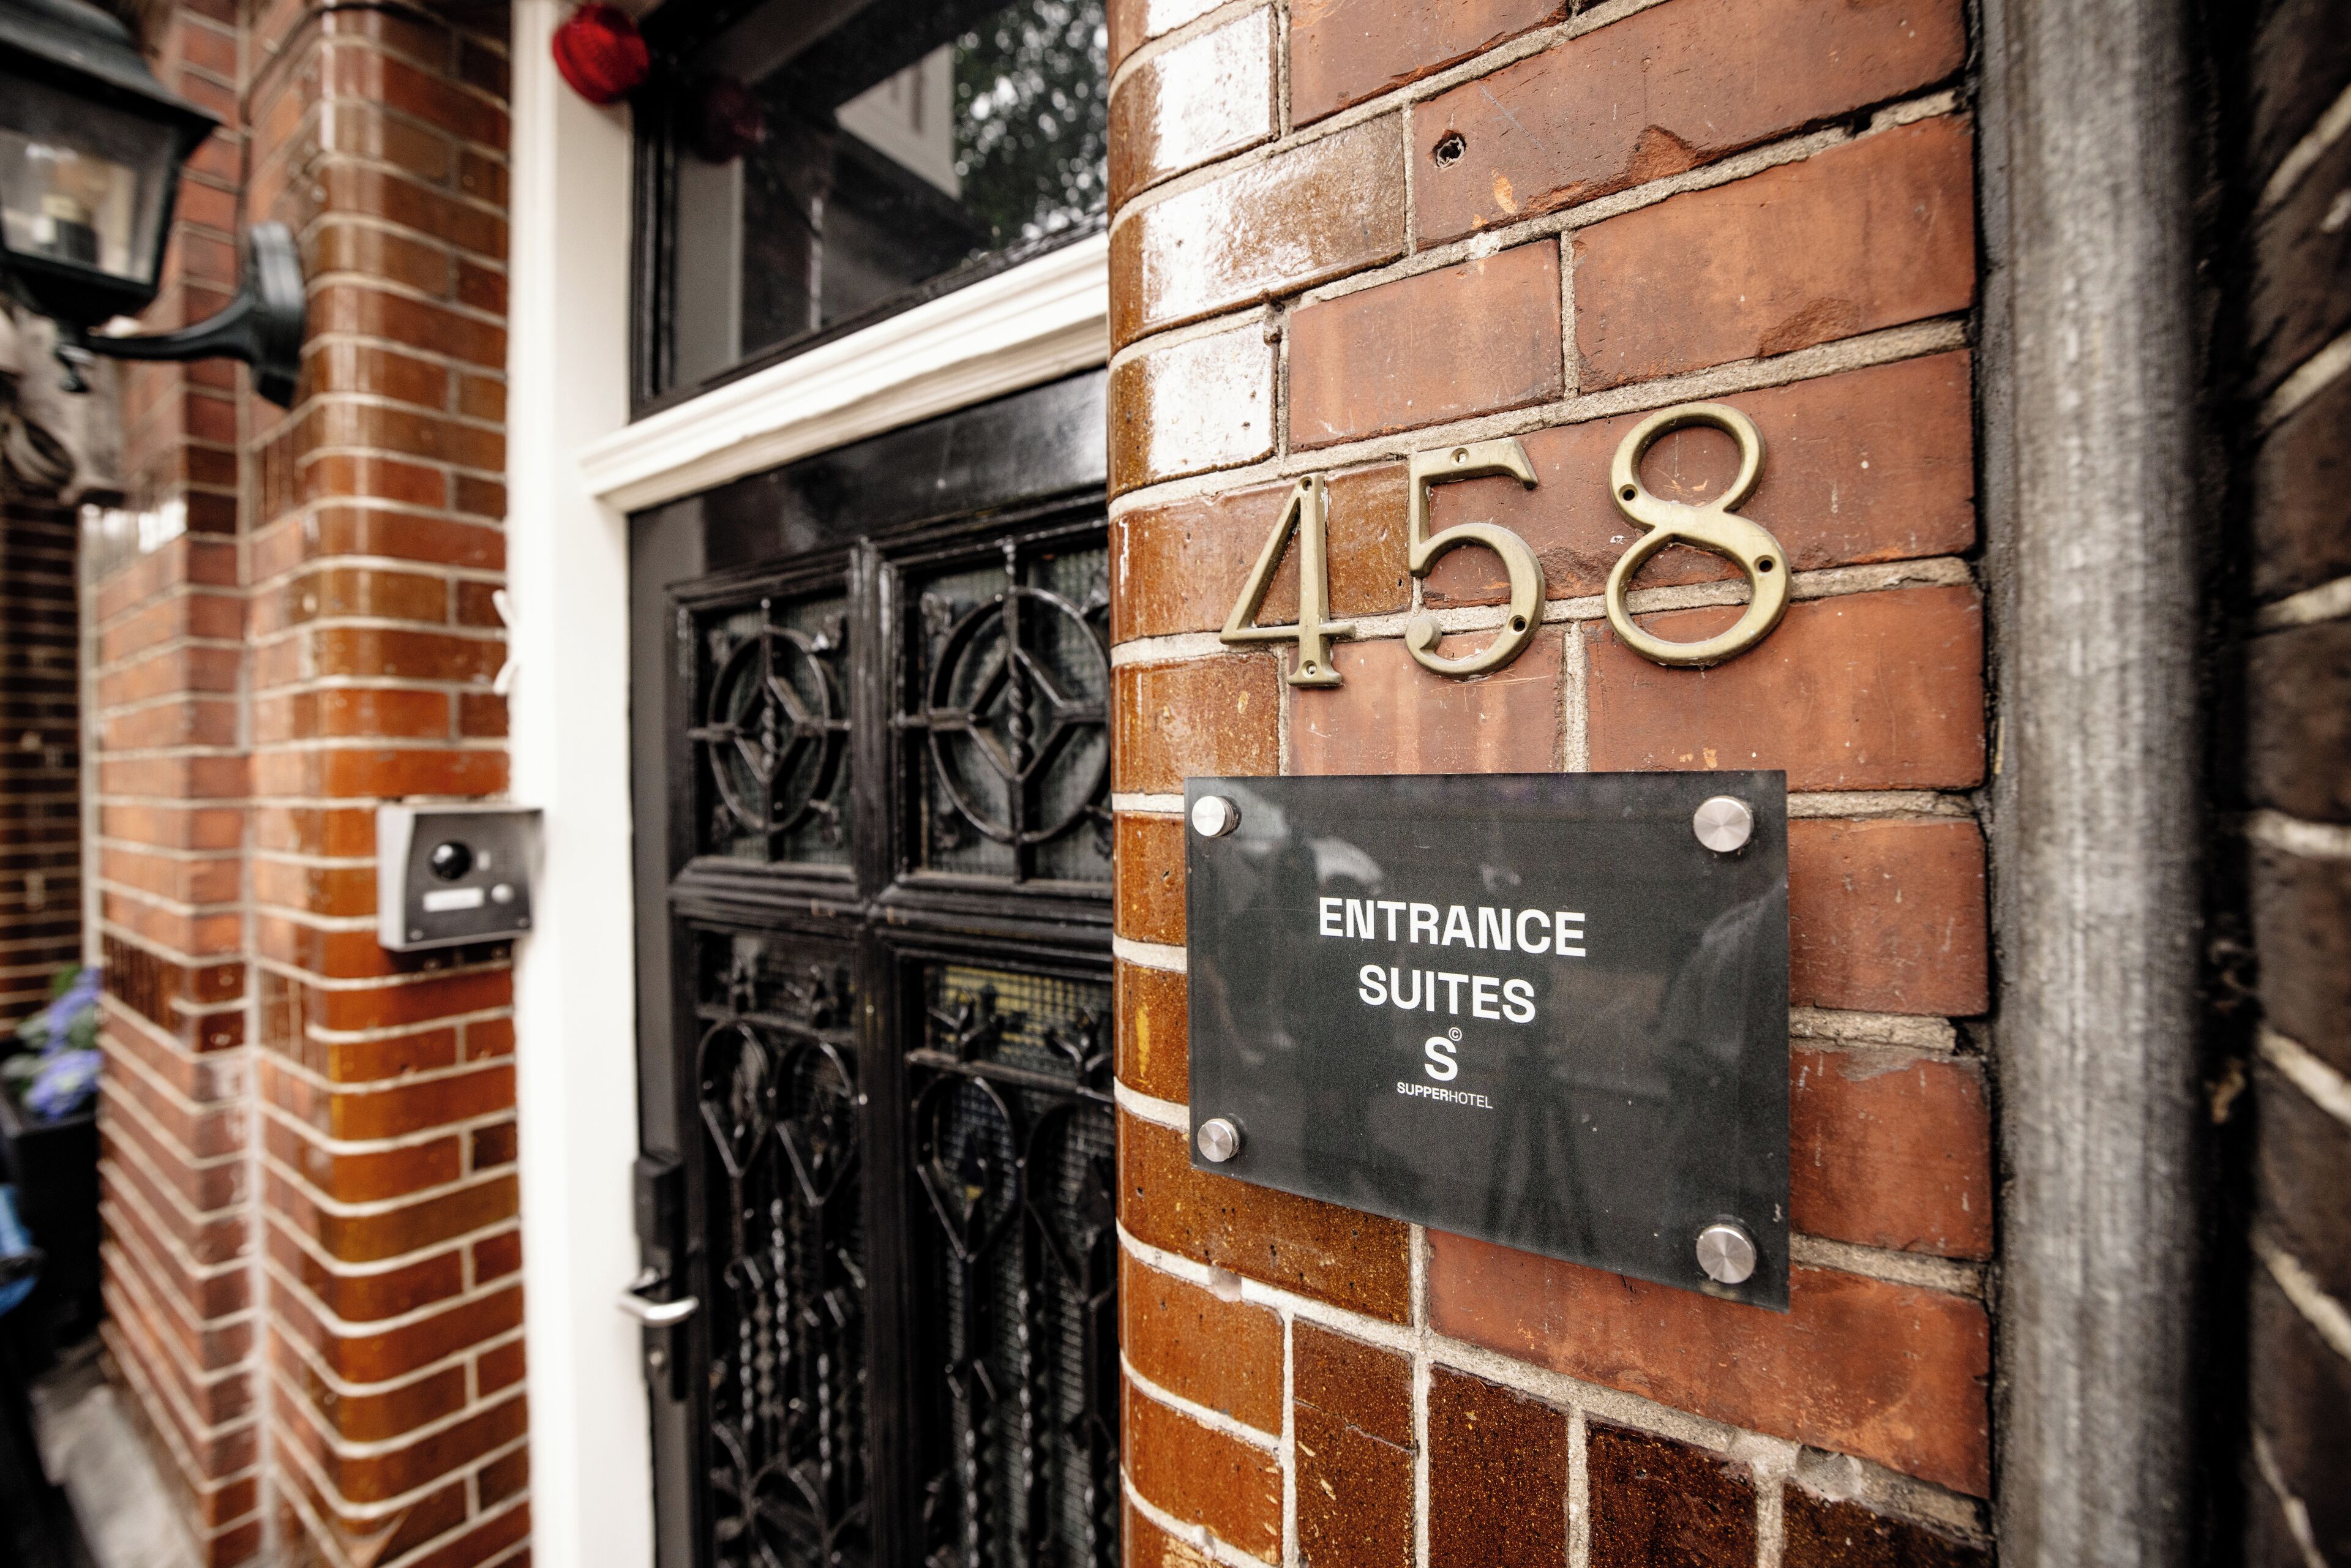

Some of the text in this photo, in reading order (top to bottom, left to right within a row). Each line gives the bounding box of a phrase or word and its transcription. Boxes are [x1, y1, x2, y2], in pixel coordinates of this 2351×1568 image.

[1220, 402, 1791, 688] 458
[1319, 896, 1586, 957] ENTRANCE
[1359, 964, 1536, 1023] SUITES
[1397, 1081, 1493, 1109] SUPPERHOTEL
